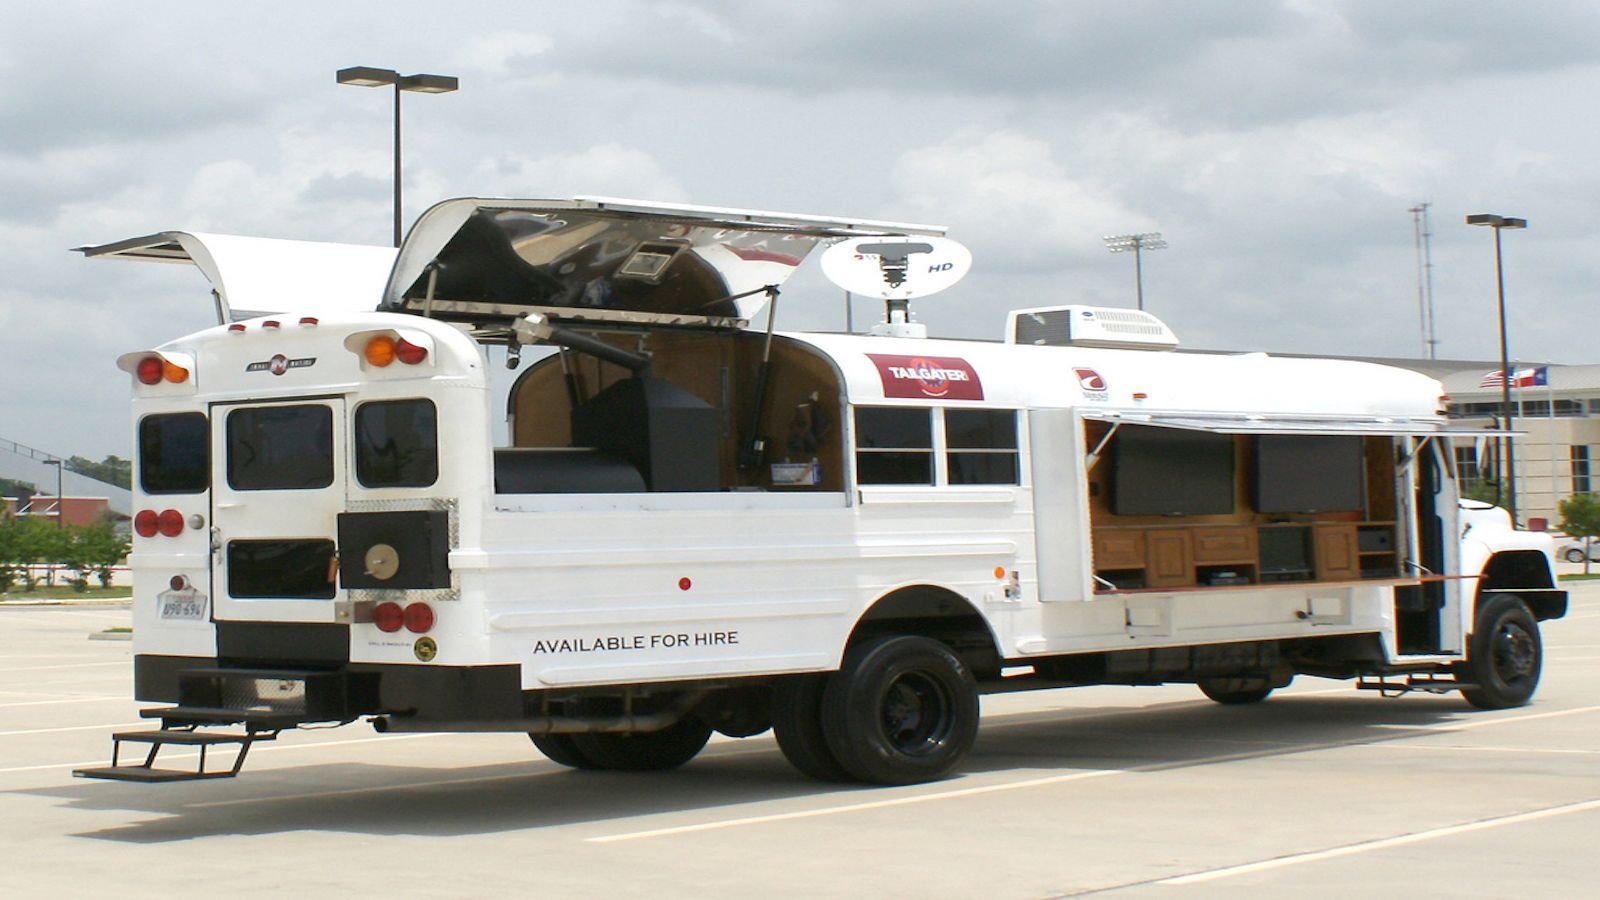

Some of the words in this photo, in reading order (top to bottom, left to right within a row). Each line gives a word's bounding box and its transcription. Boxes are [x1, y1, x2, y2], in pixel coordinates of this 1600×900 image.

[928, 262, 954, 273] HD
[888, 366, 968, 381] TAILGATER
[534, 636, 644, 653] AVAILABLE
[650, 633, 690, 648] FOR
[695, 631, 739, 646] HIRE
